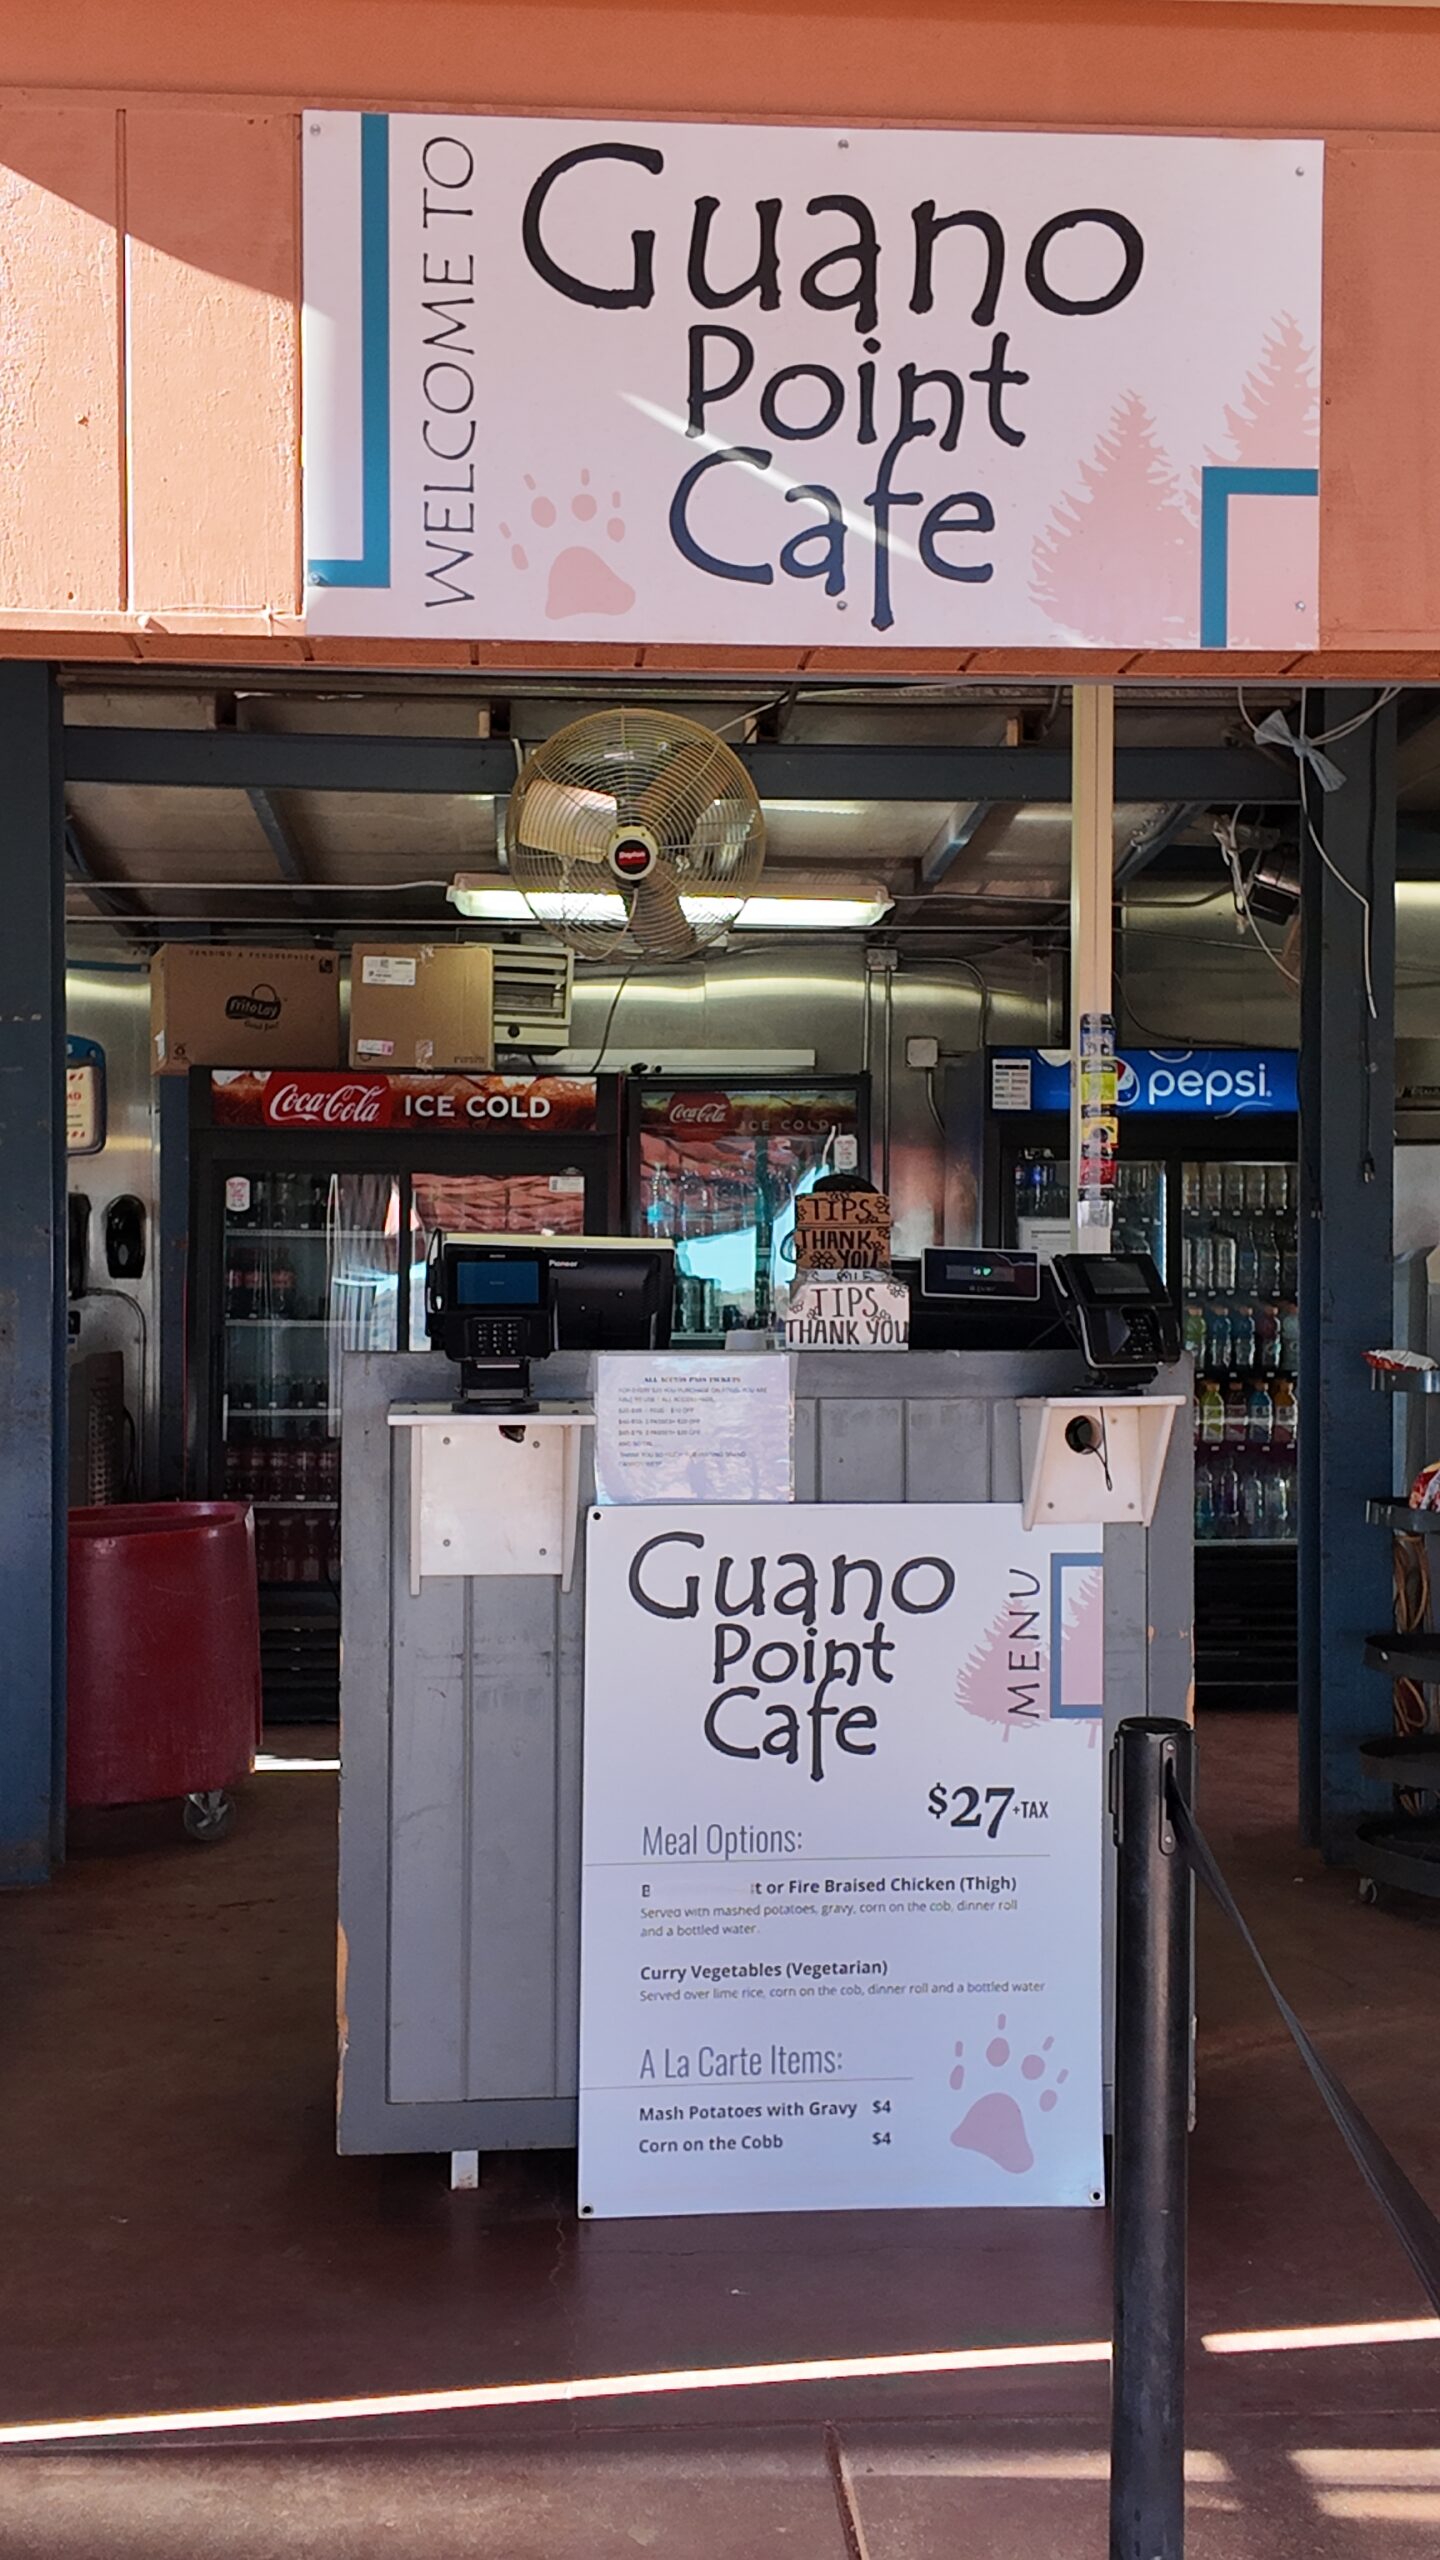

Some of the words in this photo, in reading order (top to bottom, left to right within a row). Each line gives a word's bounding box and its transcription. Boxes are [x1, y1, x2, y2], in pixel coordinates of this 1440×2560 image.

[422, 136, 474, 229] TO
[522, 141, 1145, 332] Guano
[685, 324, 1029, 452] Point
[421, 252, 476, 608] WELCOME
[669, 418, 997, 631] Cafe
[269, 1083, 387, 1122] Coca-Cola
[405, 1095, 455, 1118] ICE
[466, 1095, 551, 1119] COLD
[1148, 1063, 1267, 1106] pepsi
[780, 1119, 829, 1132] COLD
[805, 1198, 872, 1222] TIPS
[798, 1228, 873, 1251] THANK
[836, 1249, 878, 1269] YOU
[810, 1286, 879, 1318] TIPS
[786, 1319, 861, 1345] THANK
[866, 1319, 910, 1345] YOU
[628, 1531, 956, 1626] Guano
[712, 1621, 896, 1687] Point
[1008, 1568, 1040, 1719] MENU
[704, 1668, 877, 1782] Cafe
[928, 1781, 1015, 1839] $27
[642, 1825, 698, 1856] Meal
[706, 1823, 804, 1861] Options:
[766, 1881, 785, 1895] or
[789, 1879, 820, 1894] Fire
[824, 1877, 886, 1893] Braised
[890, 1876, 955, 1892] Chicken
[959, 1875, 1018, 1894] (Thigh)
[640, 1907, 681, 1919] Served
[684, 1907, 710, 1918] with
[713, 1904, 760, 1917] mashed
[859, 1902, 887, 1913] corn
[889, 1902, 905, 1912] on
[907, 1899, 927, 1912] the
[956, 1899, 994, 1912] dinner
[997, 1898, 1018, 1910] roll
[640, 1925, 664, 1938] and
[666, 1927, 674, 1937] a
[676, 1924, 719, 1937] bottled
[640, 1966, 687, 1983] Curry
[690, 1962, 782, 1982] Vegetables
[786, 1960, 888, 1980] (Vegetarian)
[640, 1989, 681, 2002] Served
[683, 1989, 710, 2000] over
[713, 1987, 738, 1999] lime
[769, 1987, 797, 1998] corn
[799, 1986, 815, 1997] on
[818, 1984, 838, 1996] the
[867, 1982, 906, 1995] dinner
[908, 1981, 929, 1994] roll
[931, 1981, 954, 1994] and
[956, 1982, 964, 1993] a
[966, 1980, 1009, 1993] bottled
[1012, 1980, 1045, 1992] water
[640, 2049, 656, 2080] A
[665, 2047, 691, 2079] La
[699, 2046, 763, 2078] Carte
[770, 2044, 844, 2076] Items:
[639, 2105, 684, 2122] Mash
[689, 2103, 763, 2120] Potatoes
[767, 2101, 805, 2118] with
[809, 2100, 858, 2119] Gravy
[872, 2099, 892, 2115] $4
[638, 2138, 679, 2154] Corn
[682, 2137, 705, 2152] on
[708, 2134, 738, 2151] the
[740, 2133, 784, 2150] Cobb
[872, 2131, 892, 2147] $4
